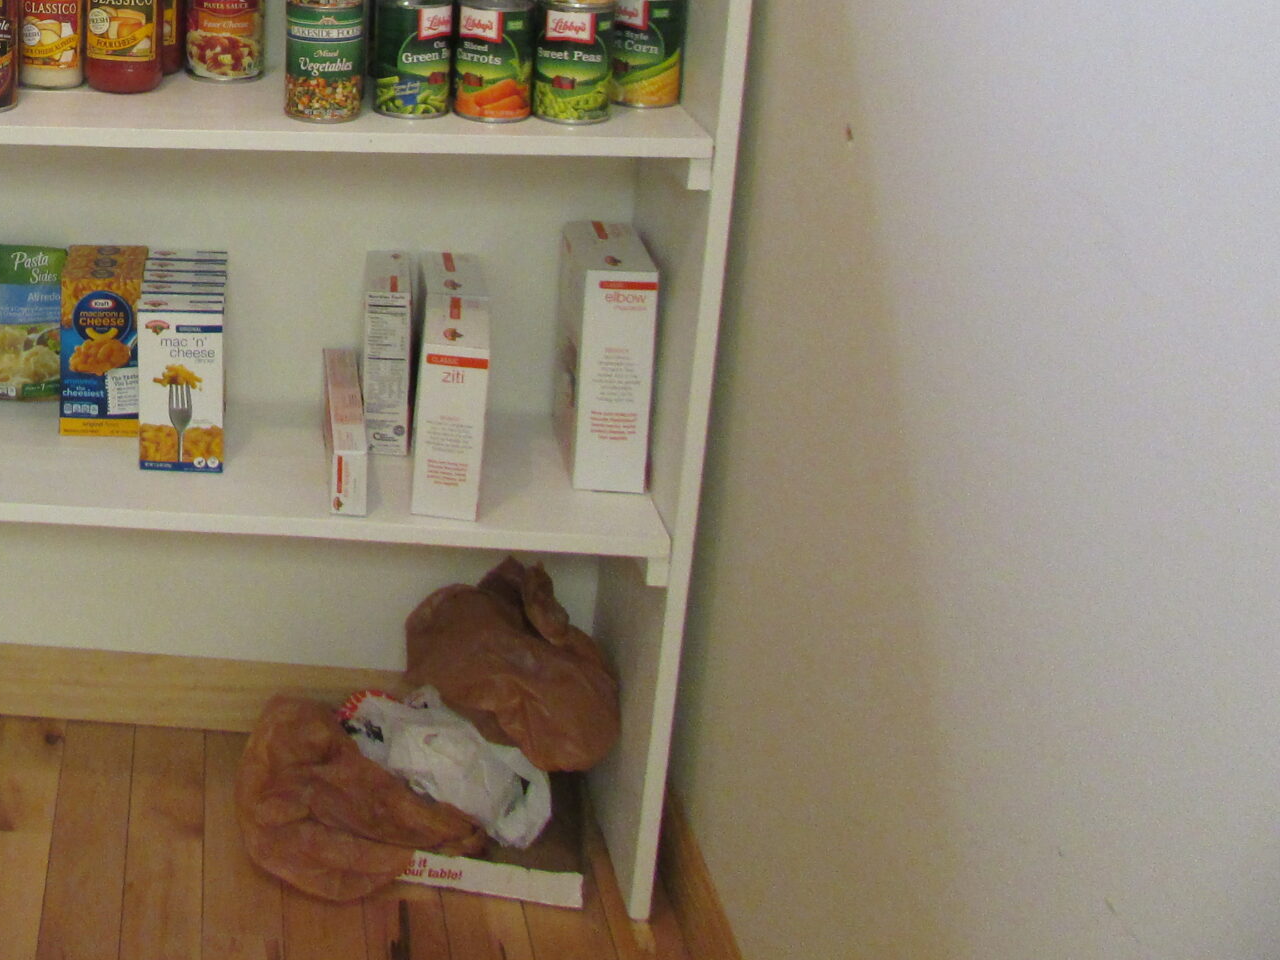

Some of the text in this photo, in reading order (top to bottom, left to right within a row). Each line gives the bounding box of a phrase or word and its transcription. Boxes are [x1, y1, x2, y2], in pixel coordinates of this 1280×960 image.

[24, 1, 77, 14] CLASSICO
[464, 41, 488, 52] Sliced
[625, 40, 659, 55] Corn
[402, 50, 439, 64] Green
[456, 48, 502, 65] Carrots
[537, 47, 602, 63] Sweet Peas
[299, 57, 352, 76] Vegetables
[11, 252, 49, 271] Pasta
[30, 268, 57, 283] Sides
[605, 292, 647, 303] elbow
[160, 338, 188, 347] mac
[170, 348, 215, 358] cheese
[441, 370, 464, 384] ziti
[62, 388, 104, 398] cheesiest
[428, 868, 462, 879] table!
